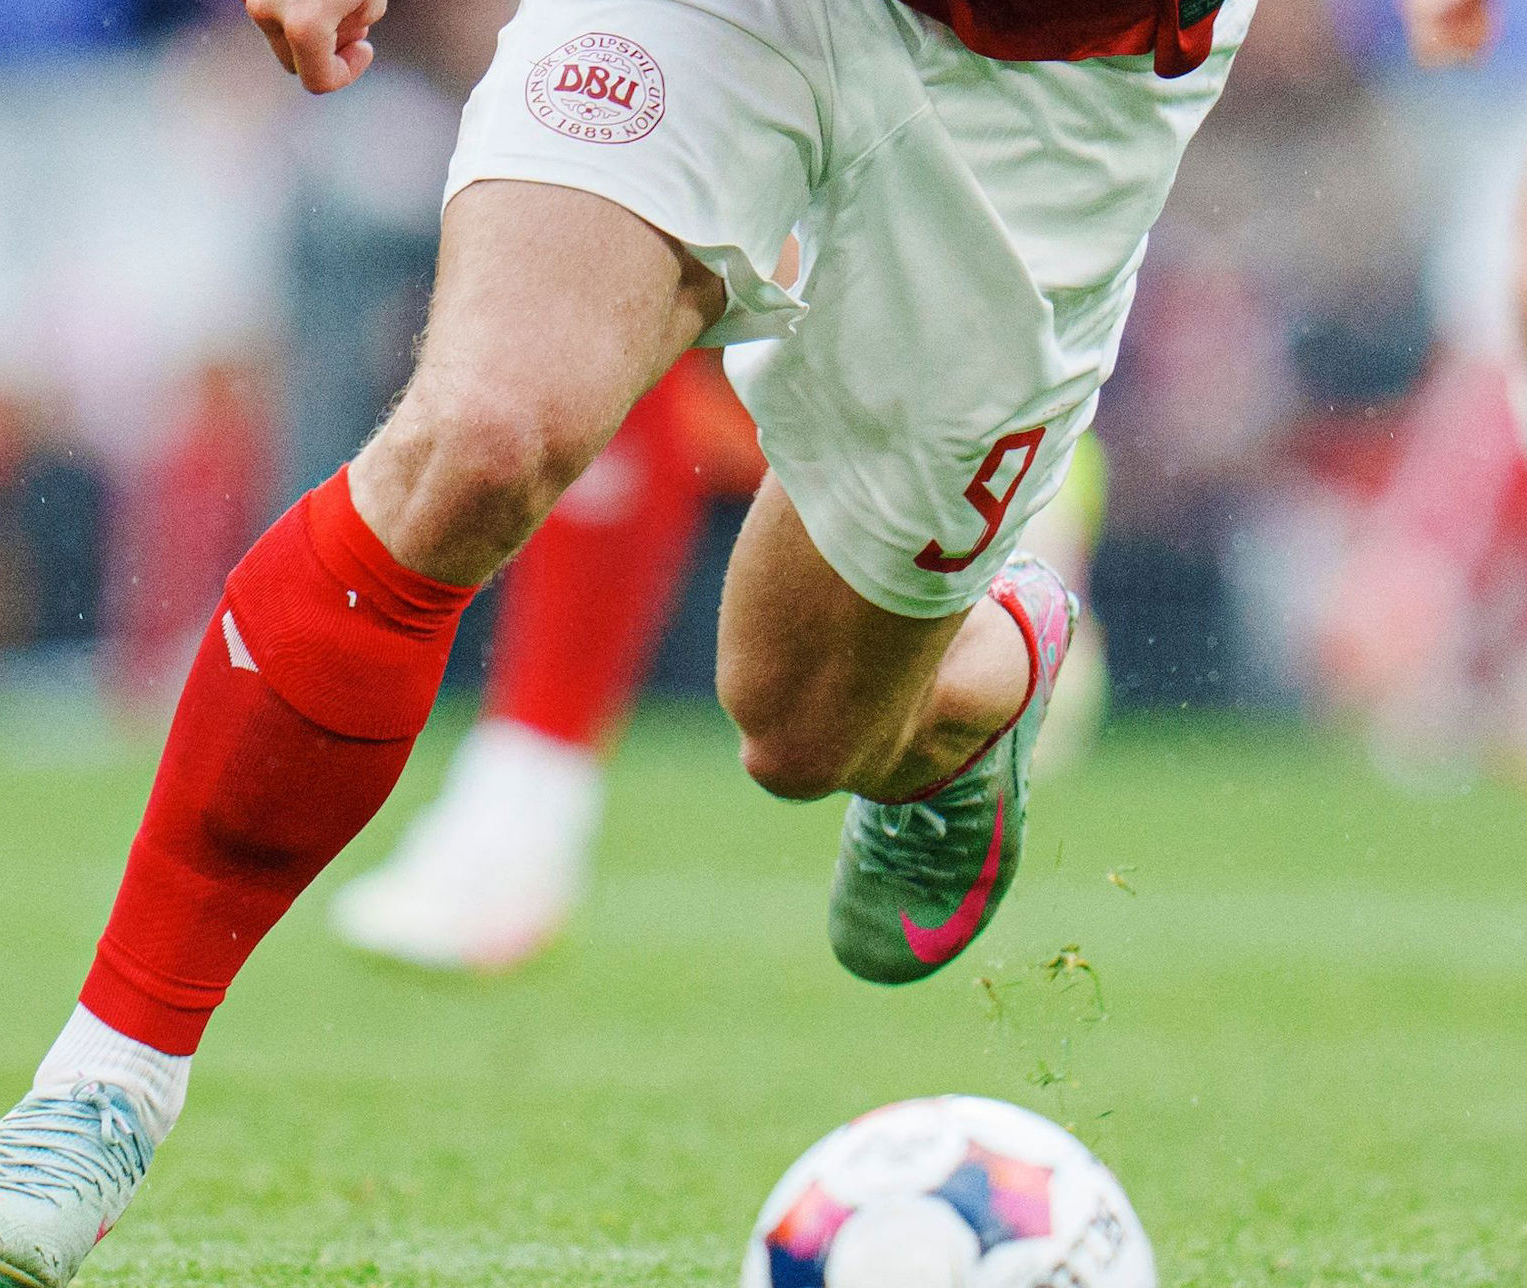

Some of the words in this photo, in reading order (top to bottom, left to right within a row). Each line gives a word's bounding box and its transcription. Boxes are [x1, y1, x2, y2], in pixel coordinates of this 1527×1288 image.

[531, 57, 560, 118] DANSK
[553, 64, 639, 110] DBU
[557, 118, 613, 140] 1889
[913, 425, 1047, 574] 9
